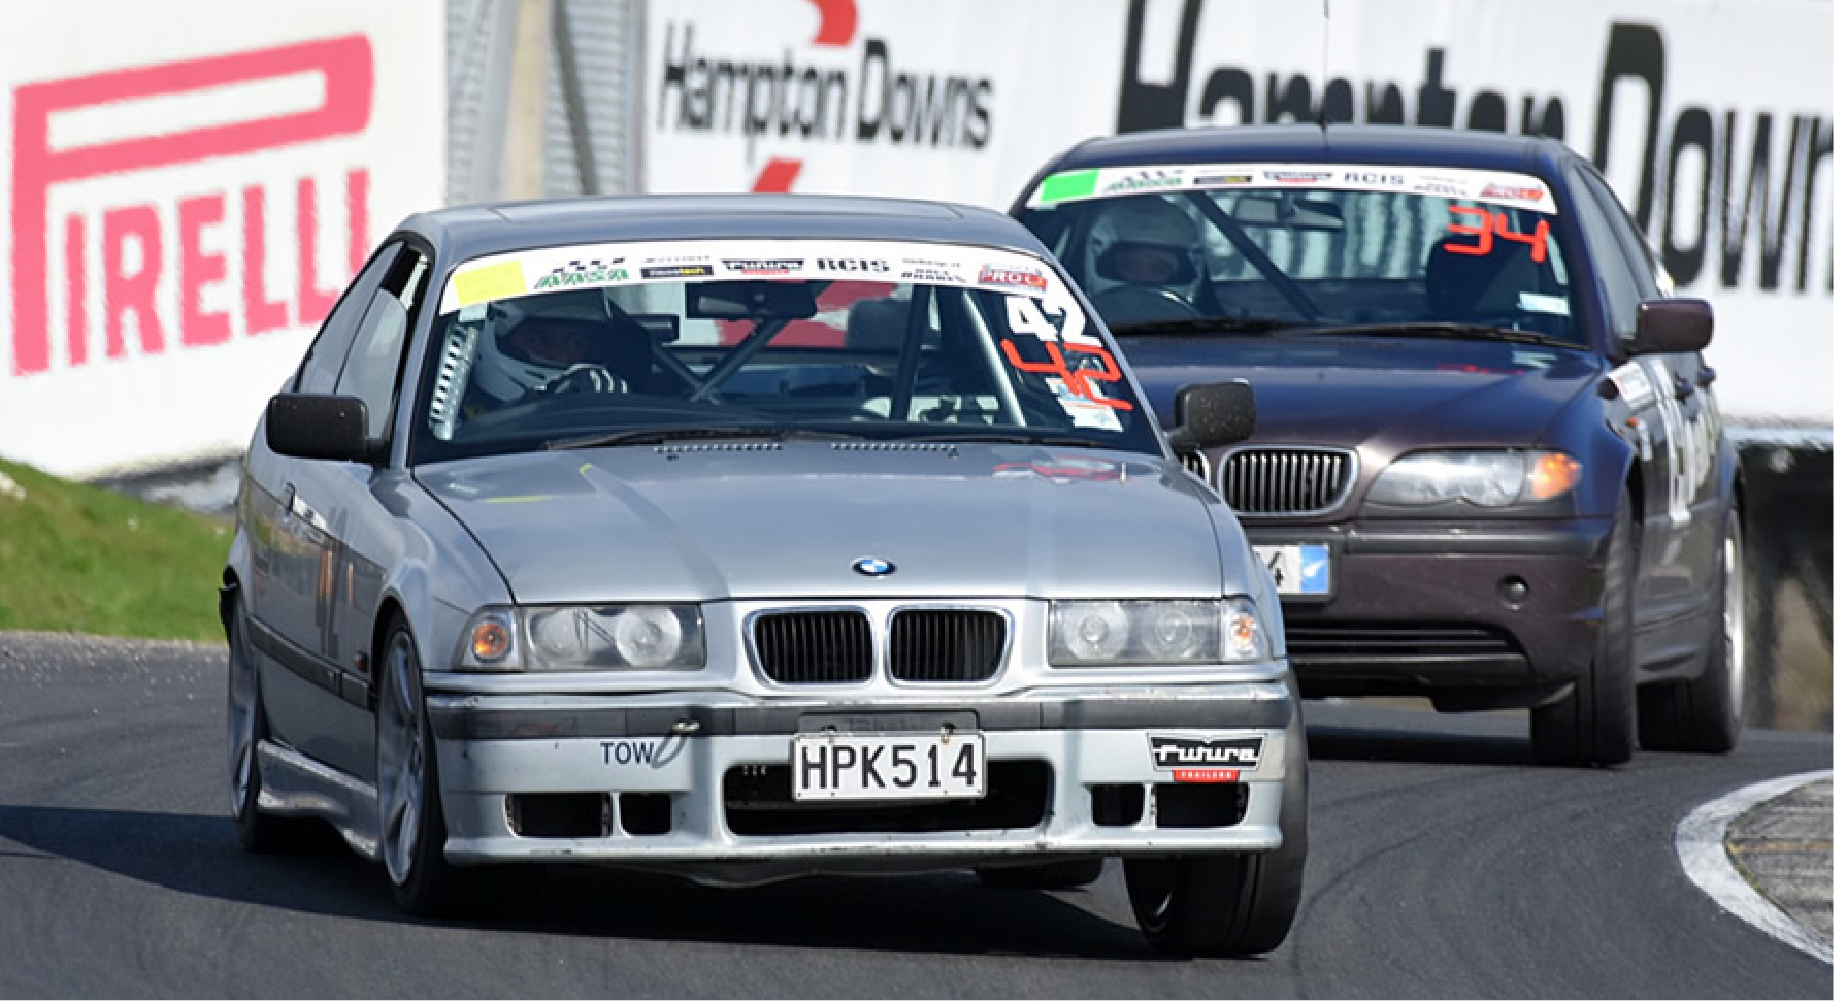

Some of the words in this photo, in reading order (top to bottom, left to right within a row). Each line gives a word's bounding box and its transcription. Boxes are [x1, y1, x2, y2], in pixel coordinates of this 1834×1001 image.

[658, 20, 846, 168] Hampton
[856, 37, 993, 150] Downs
[12, 33, 373, 376] PIRELLI
[1443, 205, 1550, 264] 34
[817, 257, 890, 272] RCIS
[1006, 295, 1103, 346] 42
[600, 742, 655, 765] TOW
[801, 743, 977, 790] HPK514
[1152, 744, 1259, 762] Futura
